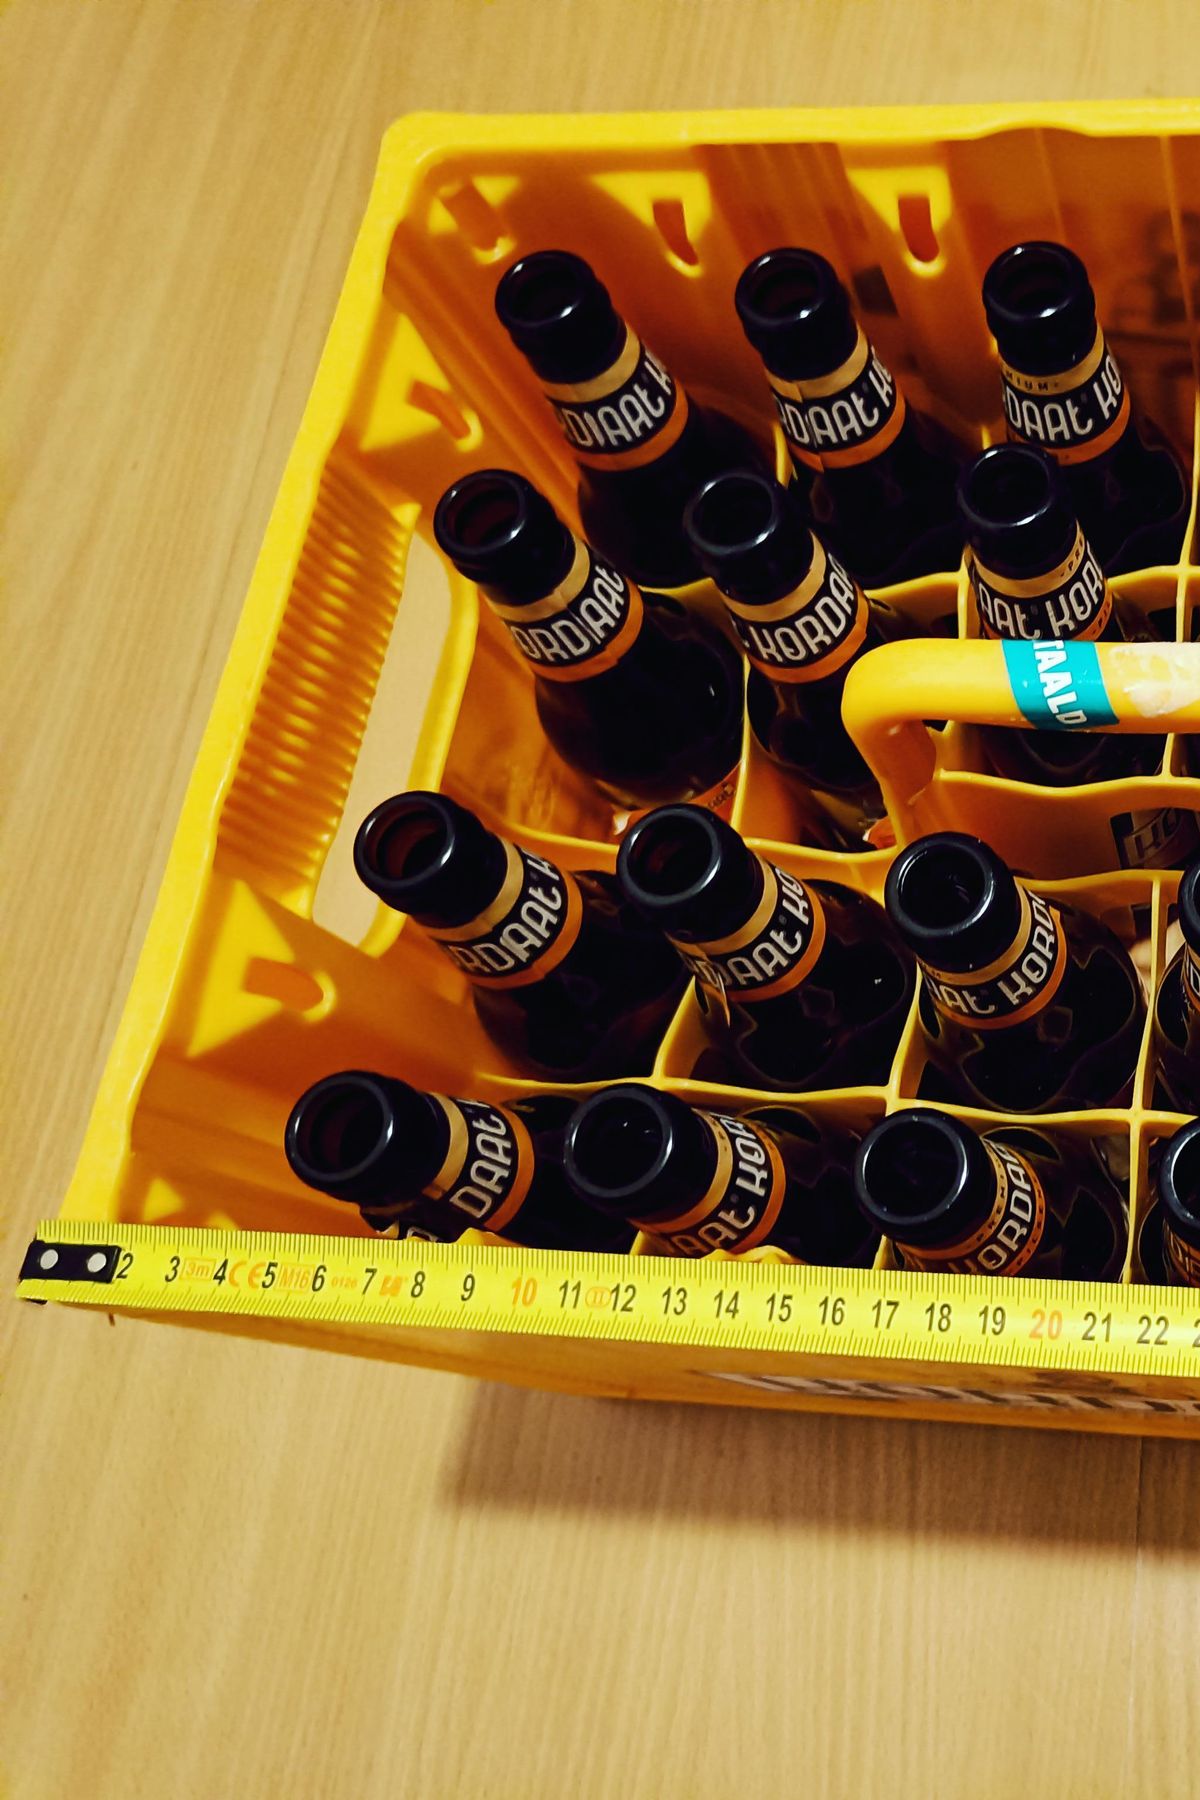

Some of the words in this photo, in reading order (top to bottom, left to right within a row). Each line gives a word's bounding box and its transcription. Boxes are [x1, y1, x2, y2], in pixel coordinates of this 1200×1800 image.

[1005, 368, 1049, 391] MIUM
[1032, 640, 1088, 725] TAALD
[116, 1253, 134, 1280] 2
[165, 1256, 181, 1283] 3
[213, 1258, 229, 1282] 4
[261, 1261, 279, 1289] 5
[311, 1264, 328, 1293] 6
[361, 1267, 378, 1296] 7
[411, 1270, 426, 1299] 8
[460, 1273, 476, 1302] 9
[510, 1277, 538, 1308] 10
[558, 1280, 581, 1309] 11
[610, 1282, 637, 1313] 12
[661, 1286, 688, 1316] 13
[713, 1289, 740, 1320] 14
[765, 1293, 793, 1323] 15
[818, 1295, 846, 1326] 16
[871, 1298, 900, 1330] 17
[924, 1301, 953, 1333] 18
[978, 1304, 1007, 1336] 19
[1029, 1307, 1063, 1341] 20
[1081, 1311, 1113, 1343] 21
[1136, 1314, 1170, 1346] 22
